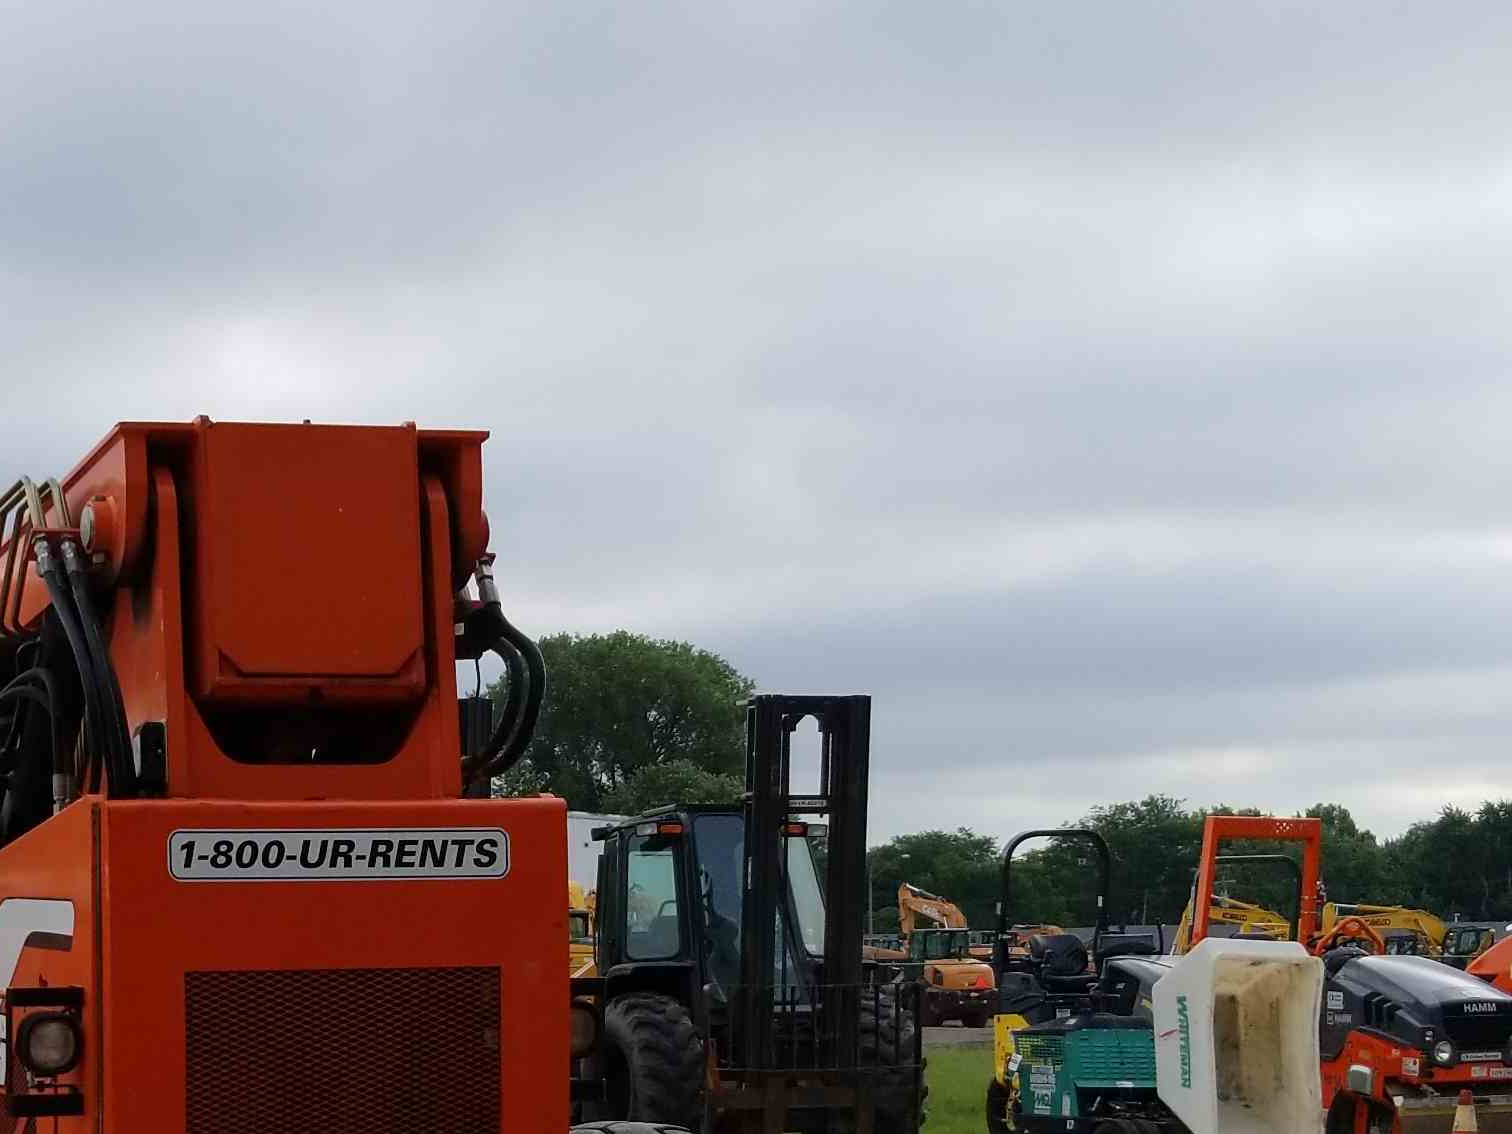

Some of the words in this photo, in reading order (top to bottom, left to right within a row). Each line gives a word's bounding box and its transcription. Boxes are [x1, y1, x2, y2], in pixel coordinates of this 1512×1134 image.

[180, 838, 499, 869] 1-800-UR-RENTS
[1463, 1002, 1497, 1013] HAMM
[1176, 995, 1192, 1089] WHITEMAN
